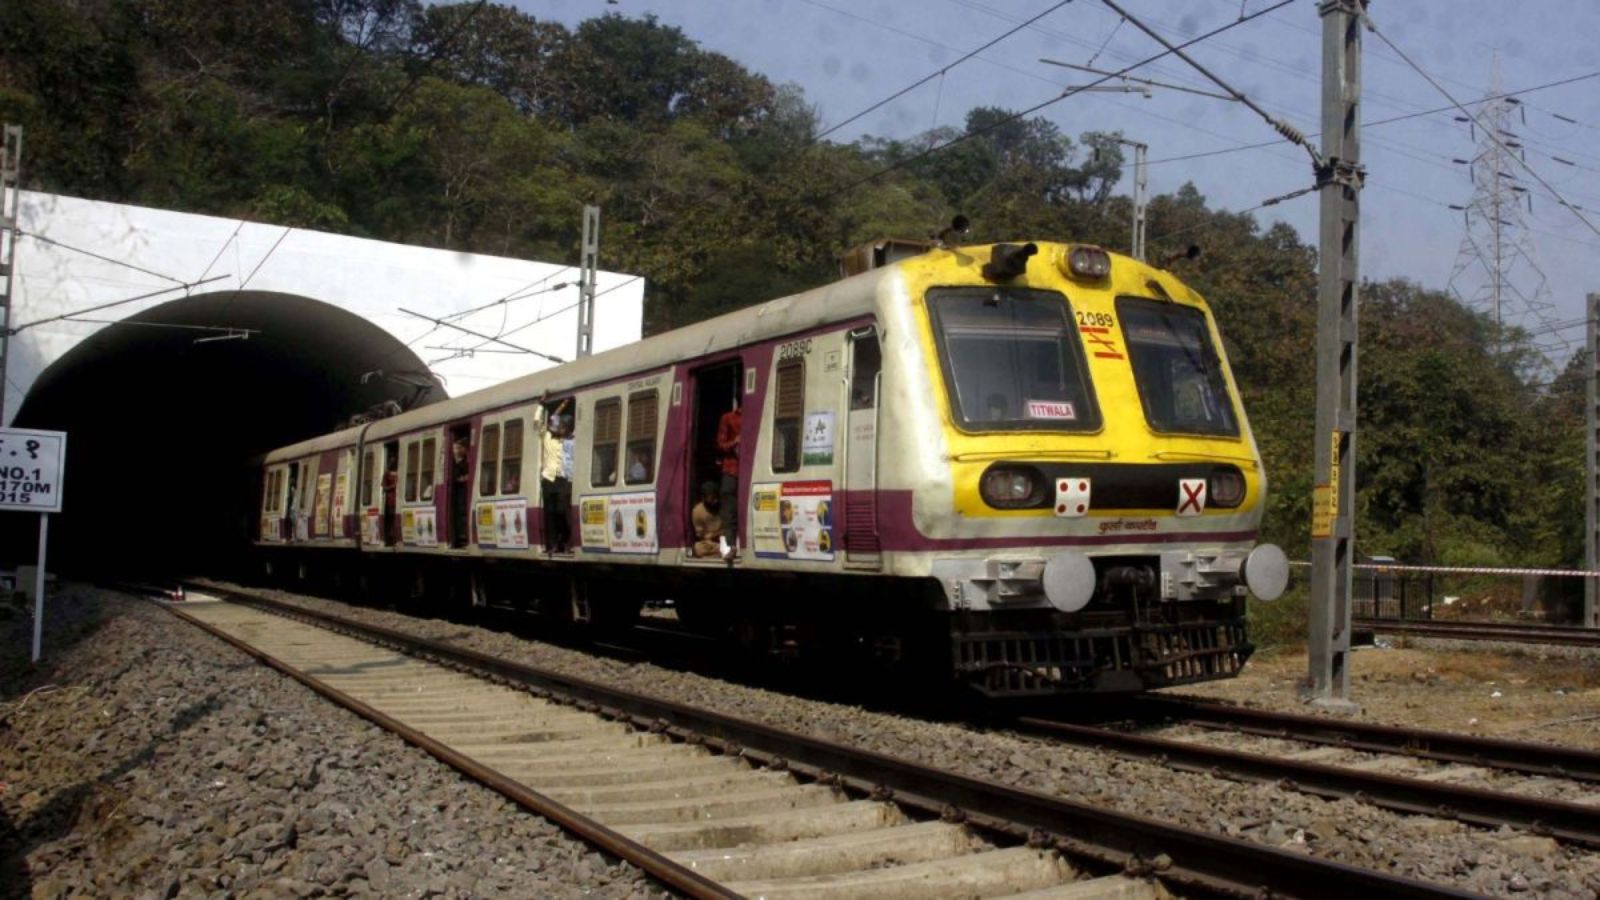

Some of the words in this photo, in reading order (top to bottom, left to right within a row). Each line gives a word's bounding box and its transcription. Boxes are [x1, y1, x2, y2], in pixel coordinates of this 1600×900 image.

[1076, 311, 1114, 327] 2089
[780, 339, 813, 360] 2089C
[1030, 404, 1073, 417] TITWALA
